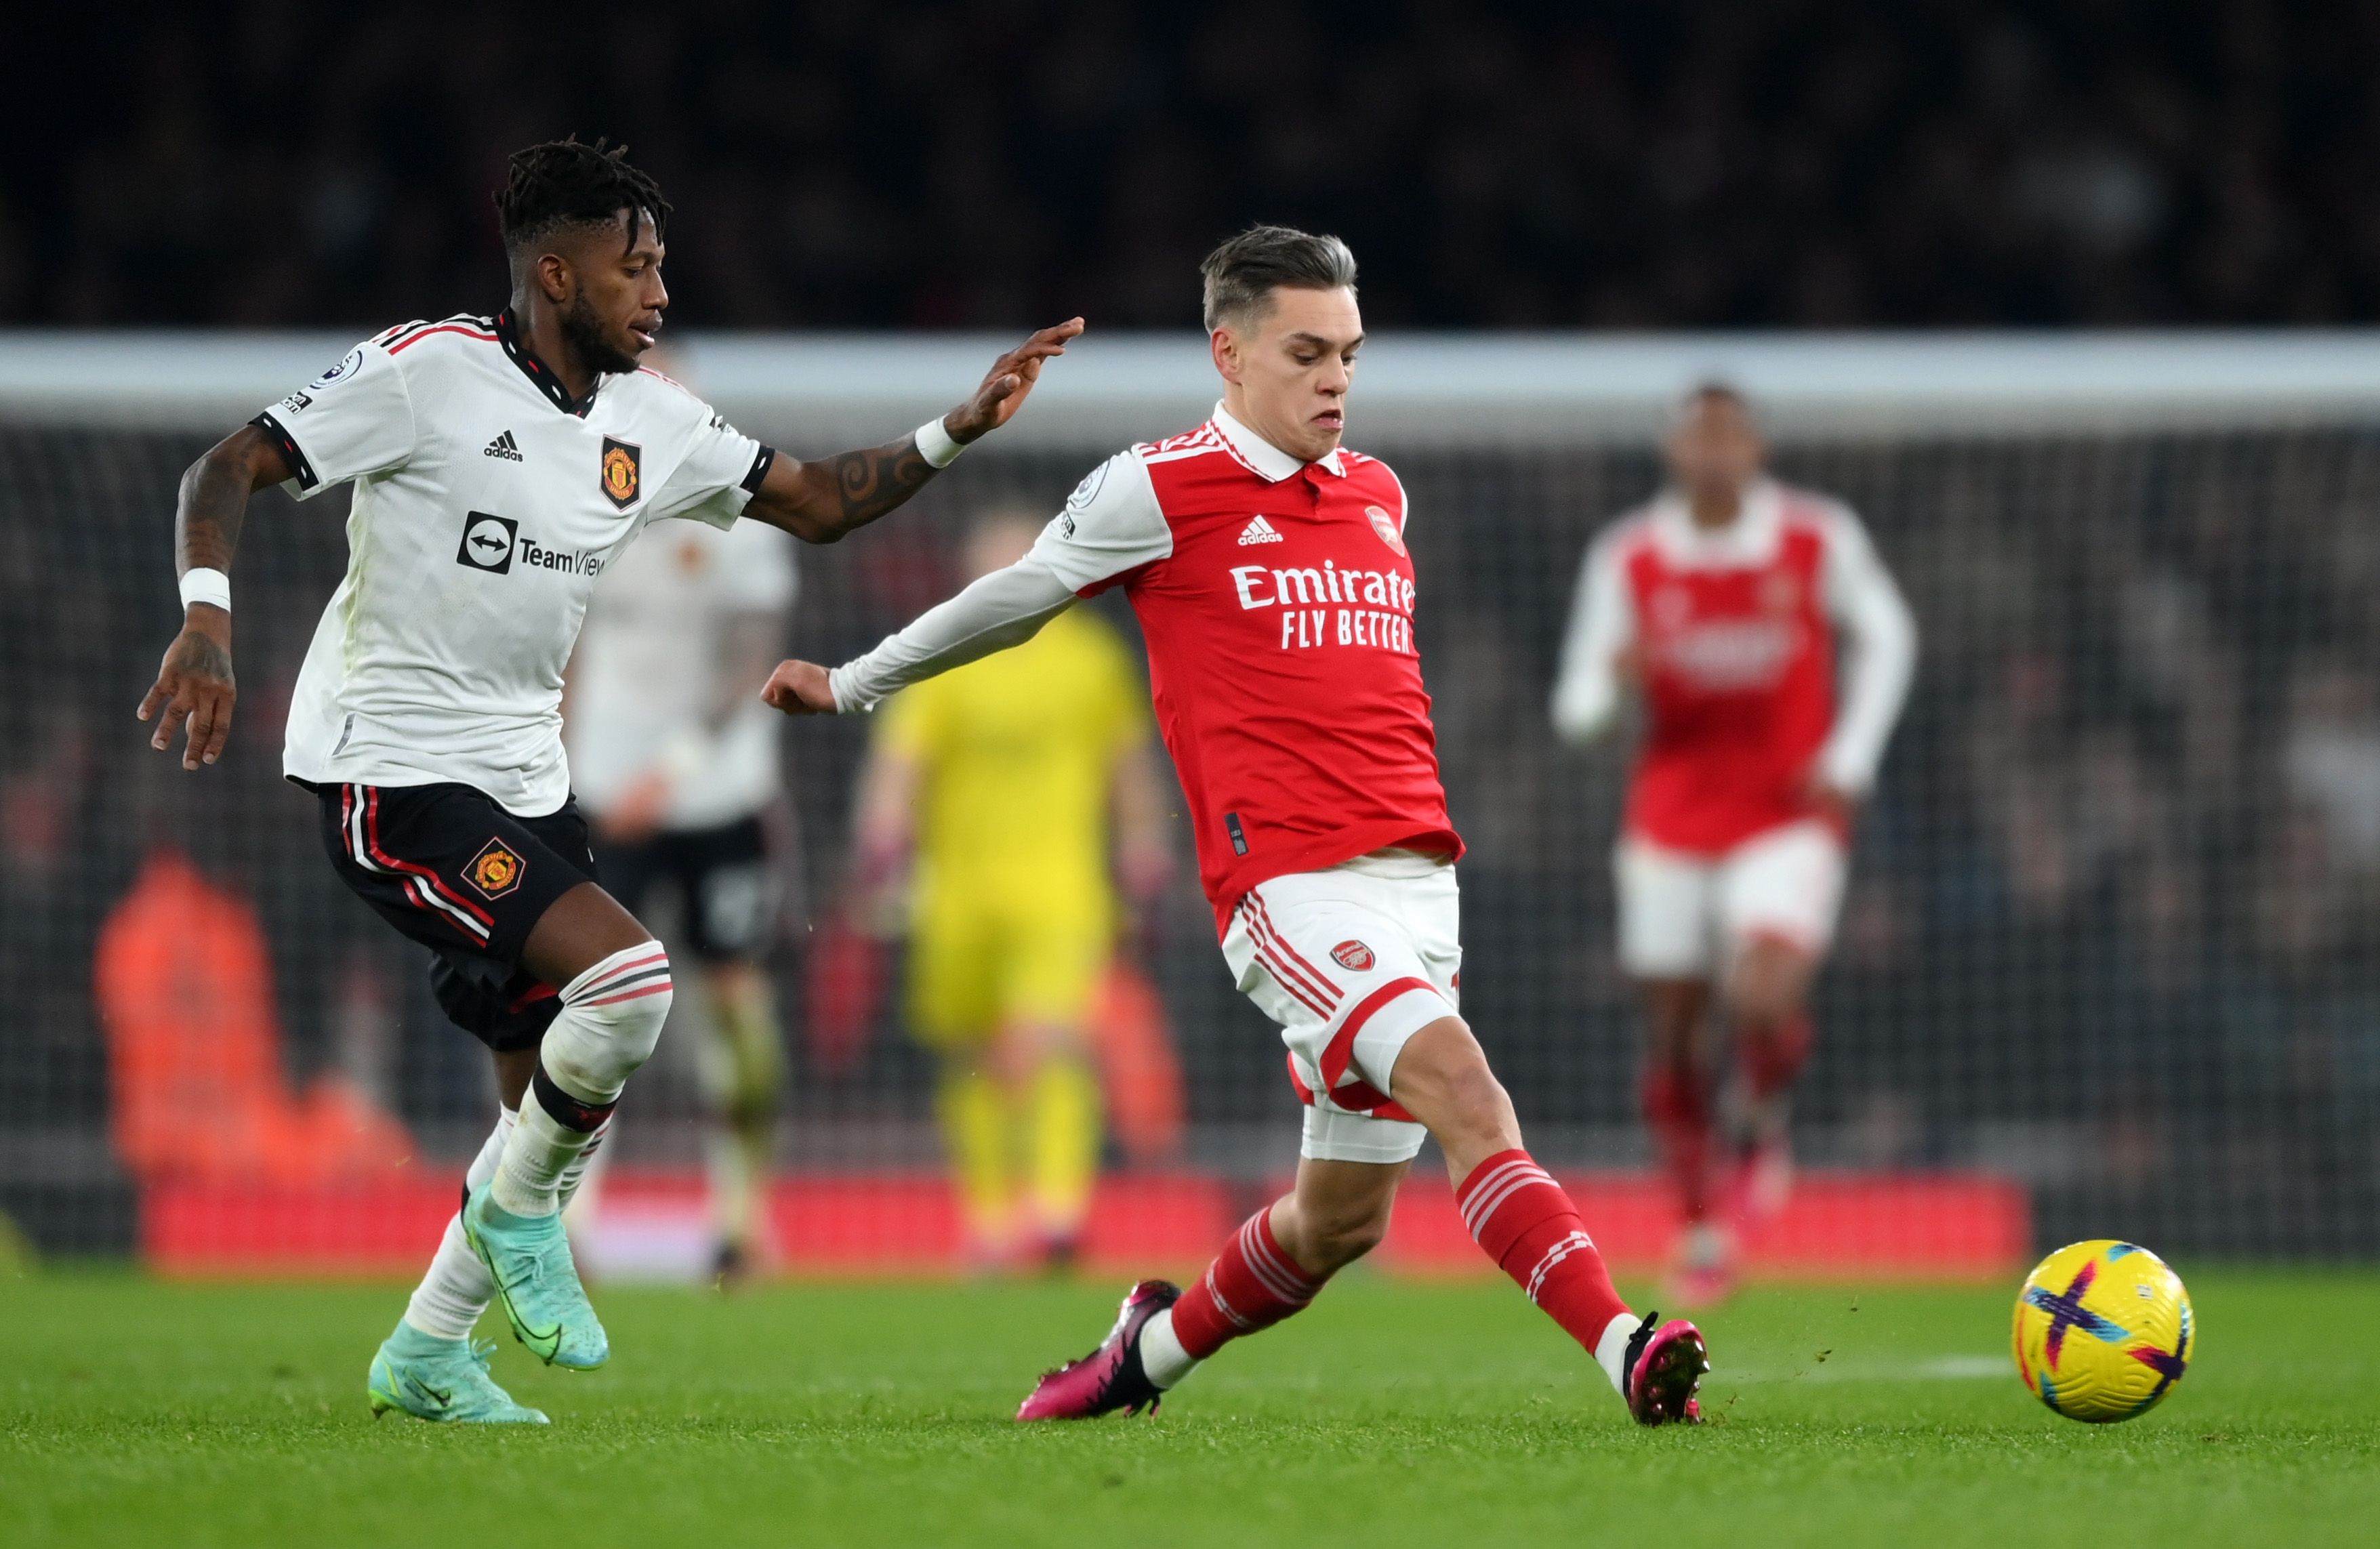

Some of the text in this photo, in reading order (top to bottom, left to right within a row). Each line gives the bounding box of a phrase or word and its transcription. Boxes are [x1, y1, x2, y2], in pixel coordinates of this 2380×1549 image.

[484, 447, 523, 462] adidas
[1237, 533, 1284, 546] adidas
[1229, 559, 1416, 614] Emirate
[1281, 609, 1410, 654] FLY BETTER
